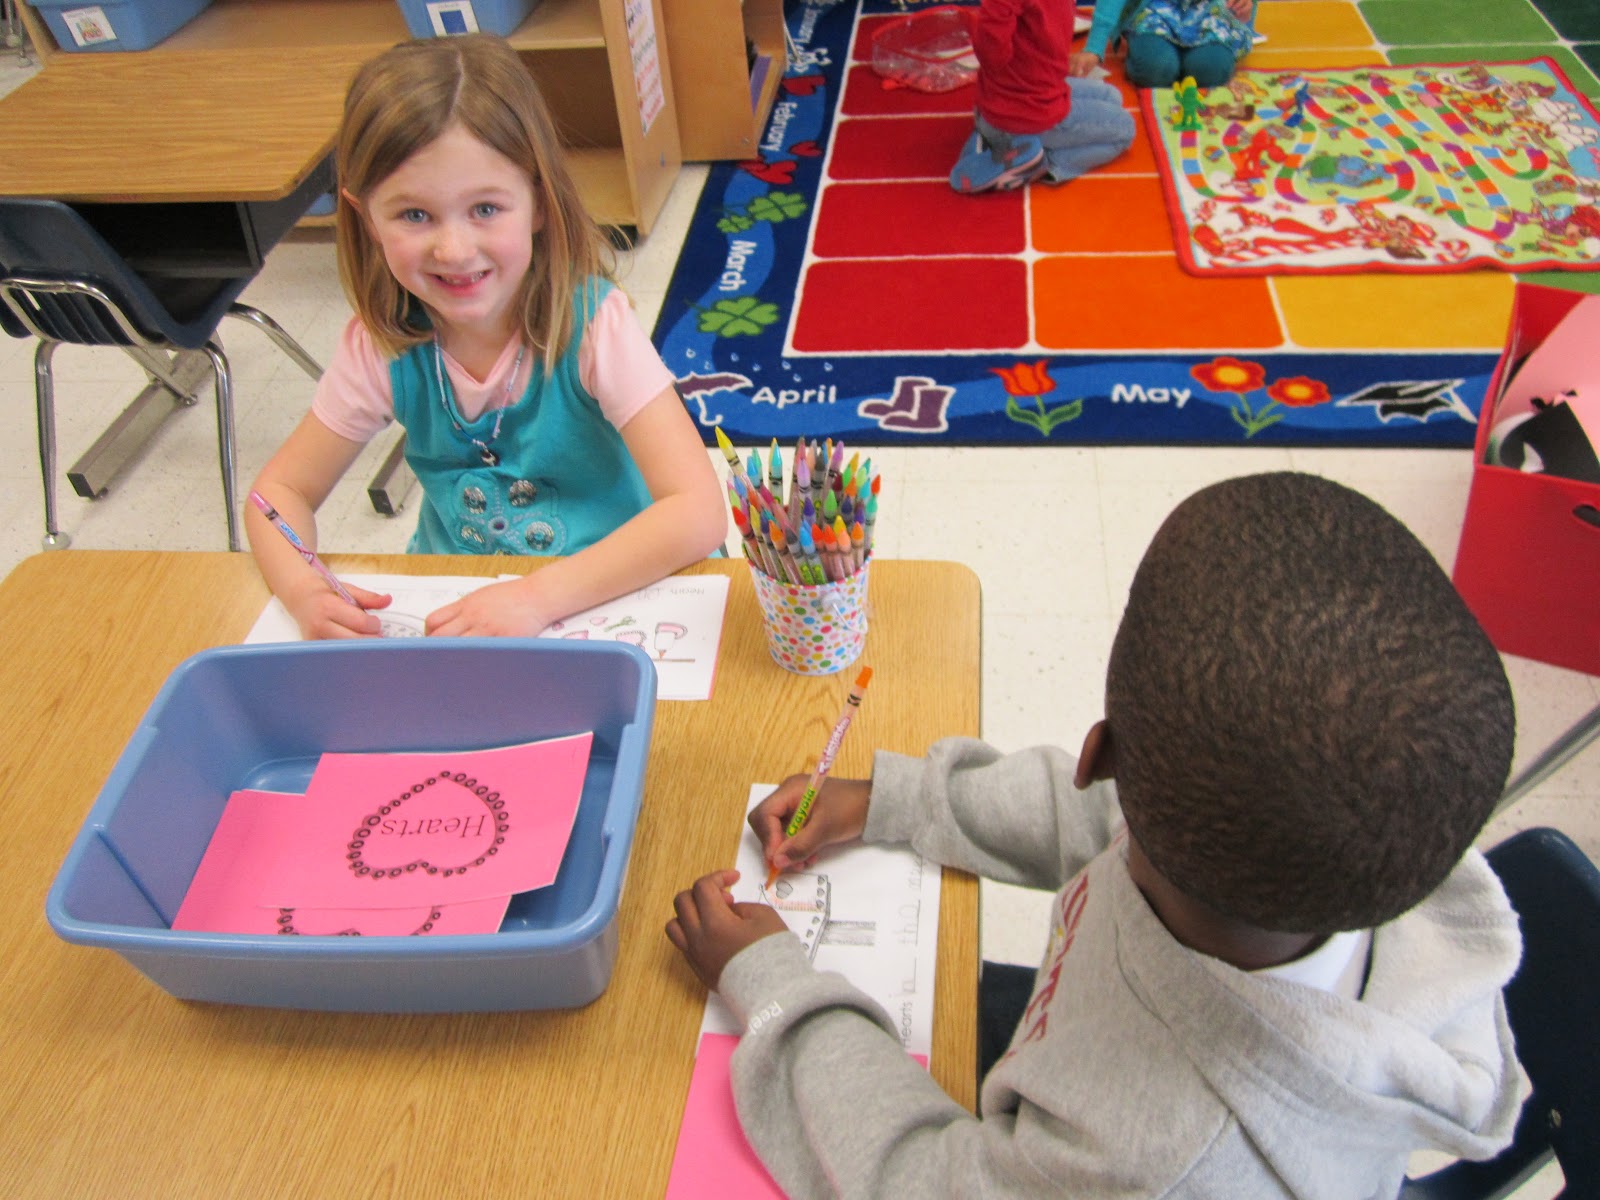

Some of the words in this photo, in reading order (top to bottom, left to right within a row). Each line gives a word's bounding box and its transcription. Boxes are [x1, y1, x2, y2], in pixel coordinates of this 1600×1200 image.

[759, 101, 798, 152] February
[719, 240, 757, 291] March
[751, 384, 837, 409] April
[1111, 383, 1192, 407] May
[380, 814, 490, 839] Hearts
[786, 788, 816, 837] Crayola
